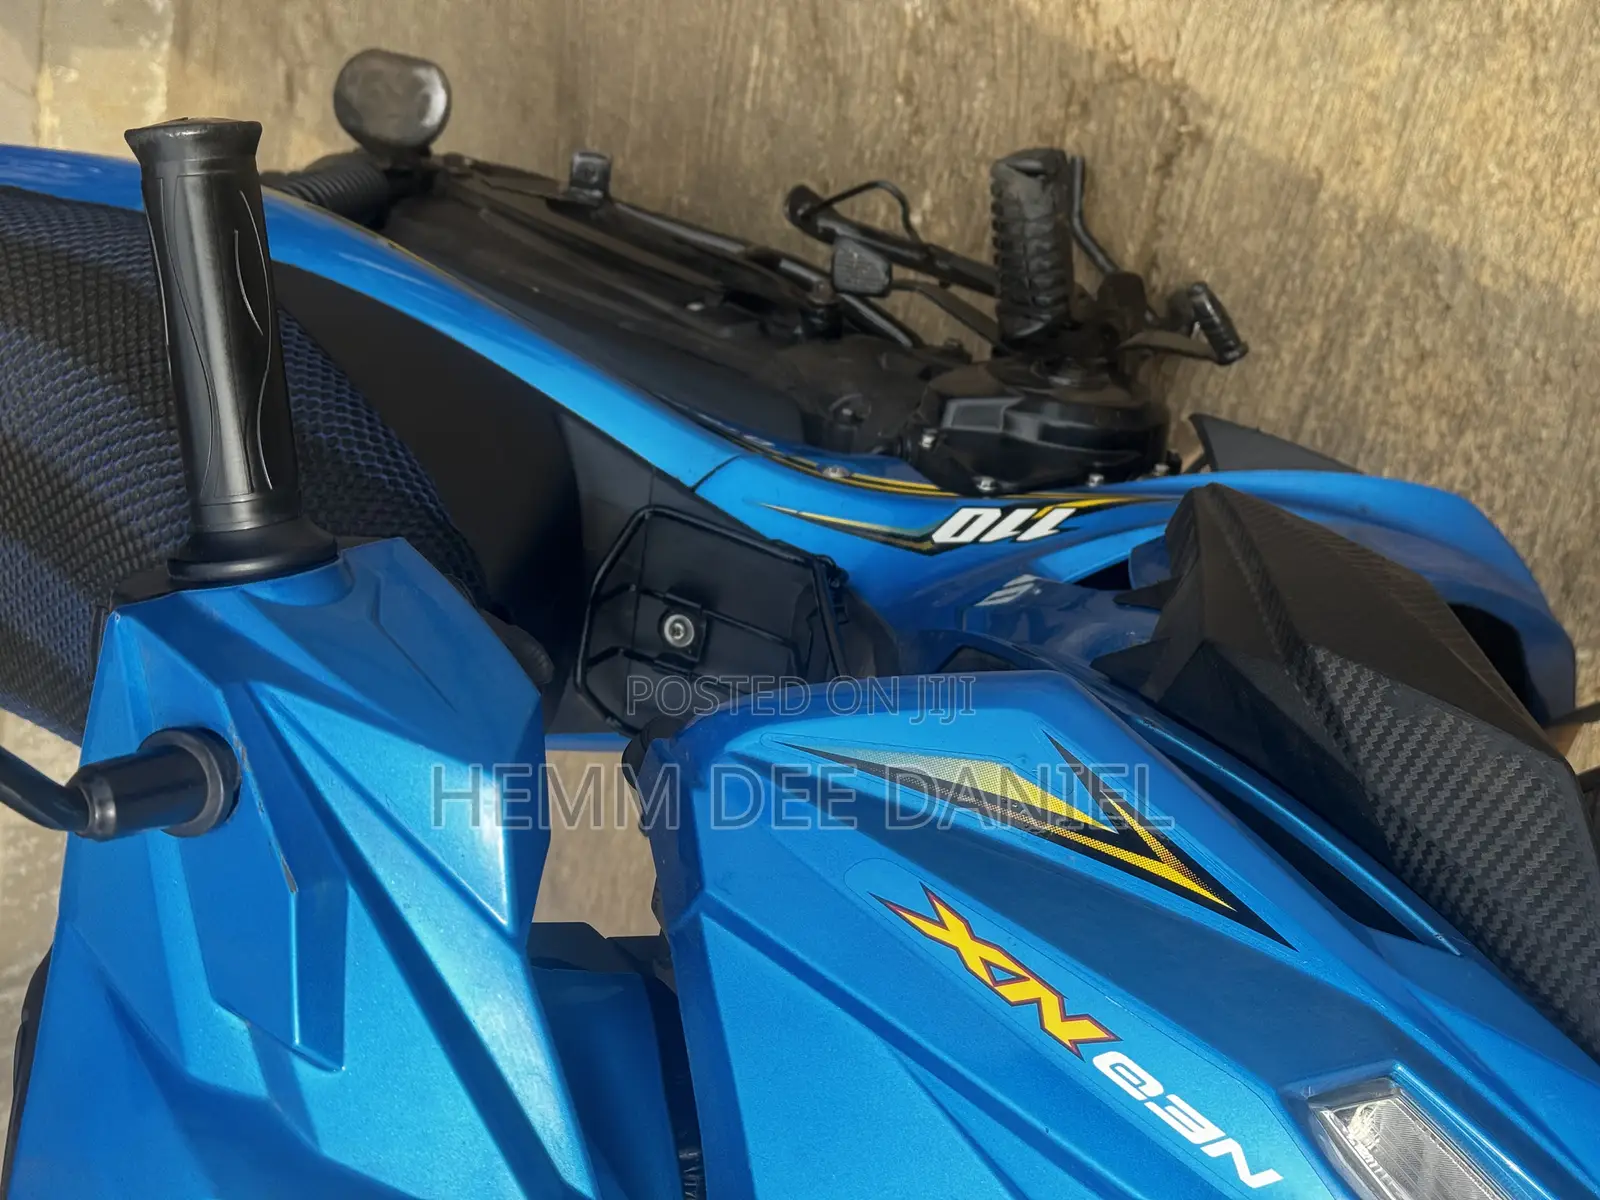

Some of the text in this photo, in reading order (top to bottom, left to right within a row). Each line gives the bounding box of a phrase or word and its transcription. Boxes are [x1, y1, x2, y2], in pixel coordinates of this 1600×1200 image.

[931, 507, 1077, 544] 110
[867, 881, 1284, 1189] NEO NX
